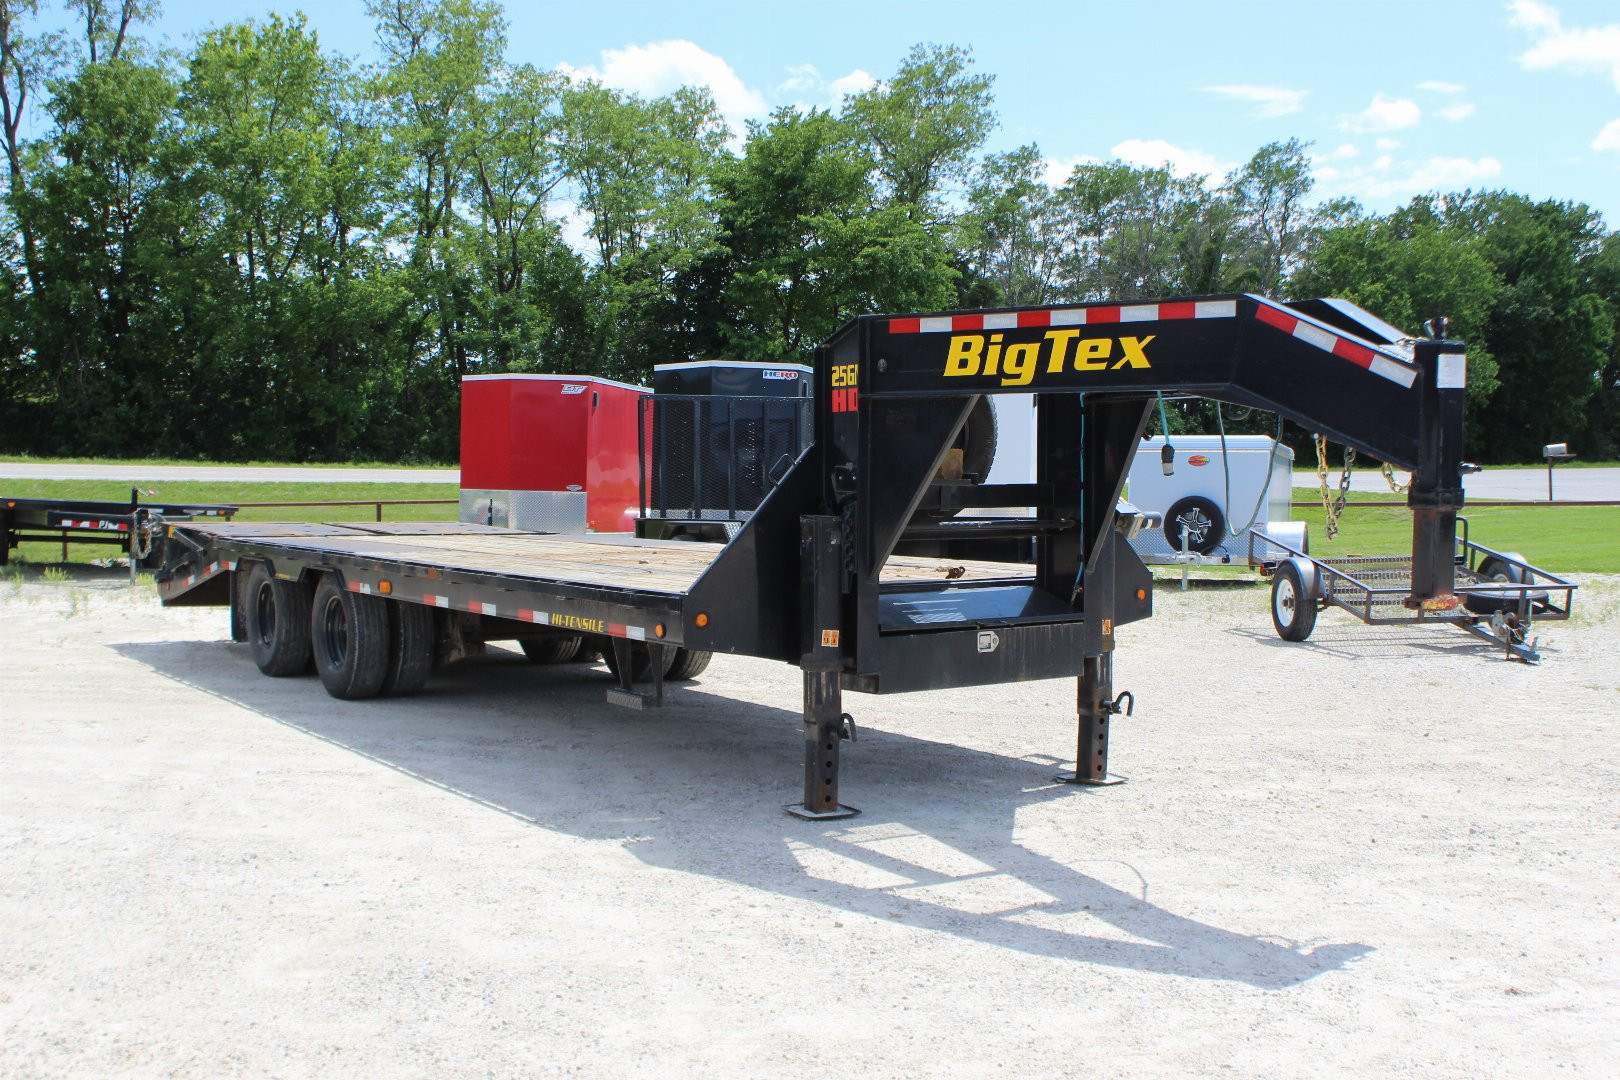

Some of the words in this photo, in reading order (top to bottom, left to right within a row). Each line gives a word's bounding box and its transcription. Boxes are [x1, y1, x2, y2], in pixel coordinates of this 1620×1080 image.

[763, 370, 798, 379] HERO
[99, 520, 109, 530] PJ
[551, 613, 605, 633] HI-TENSILE
